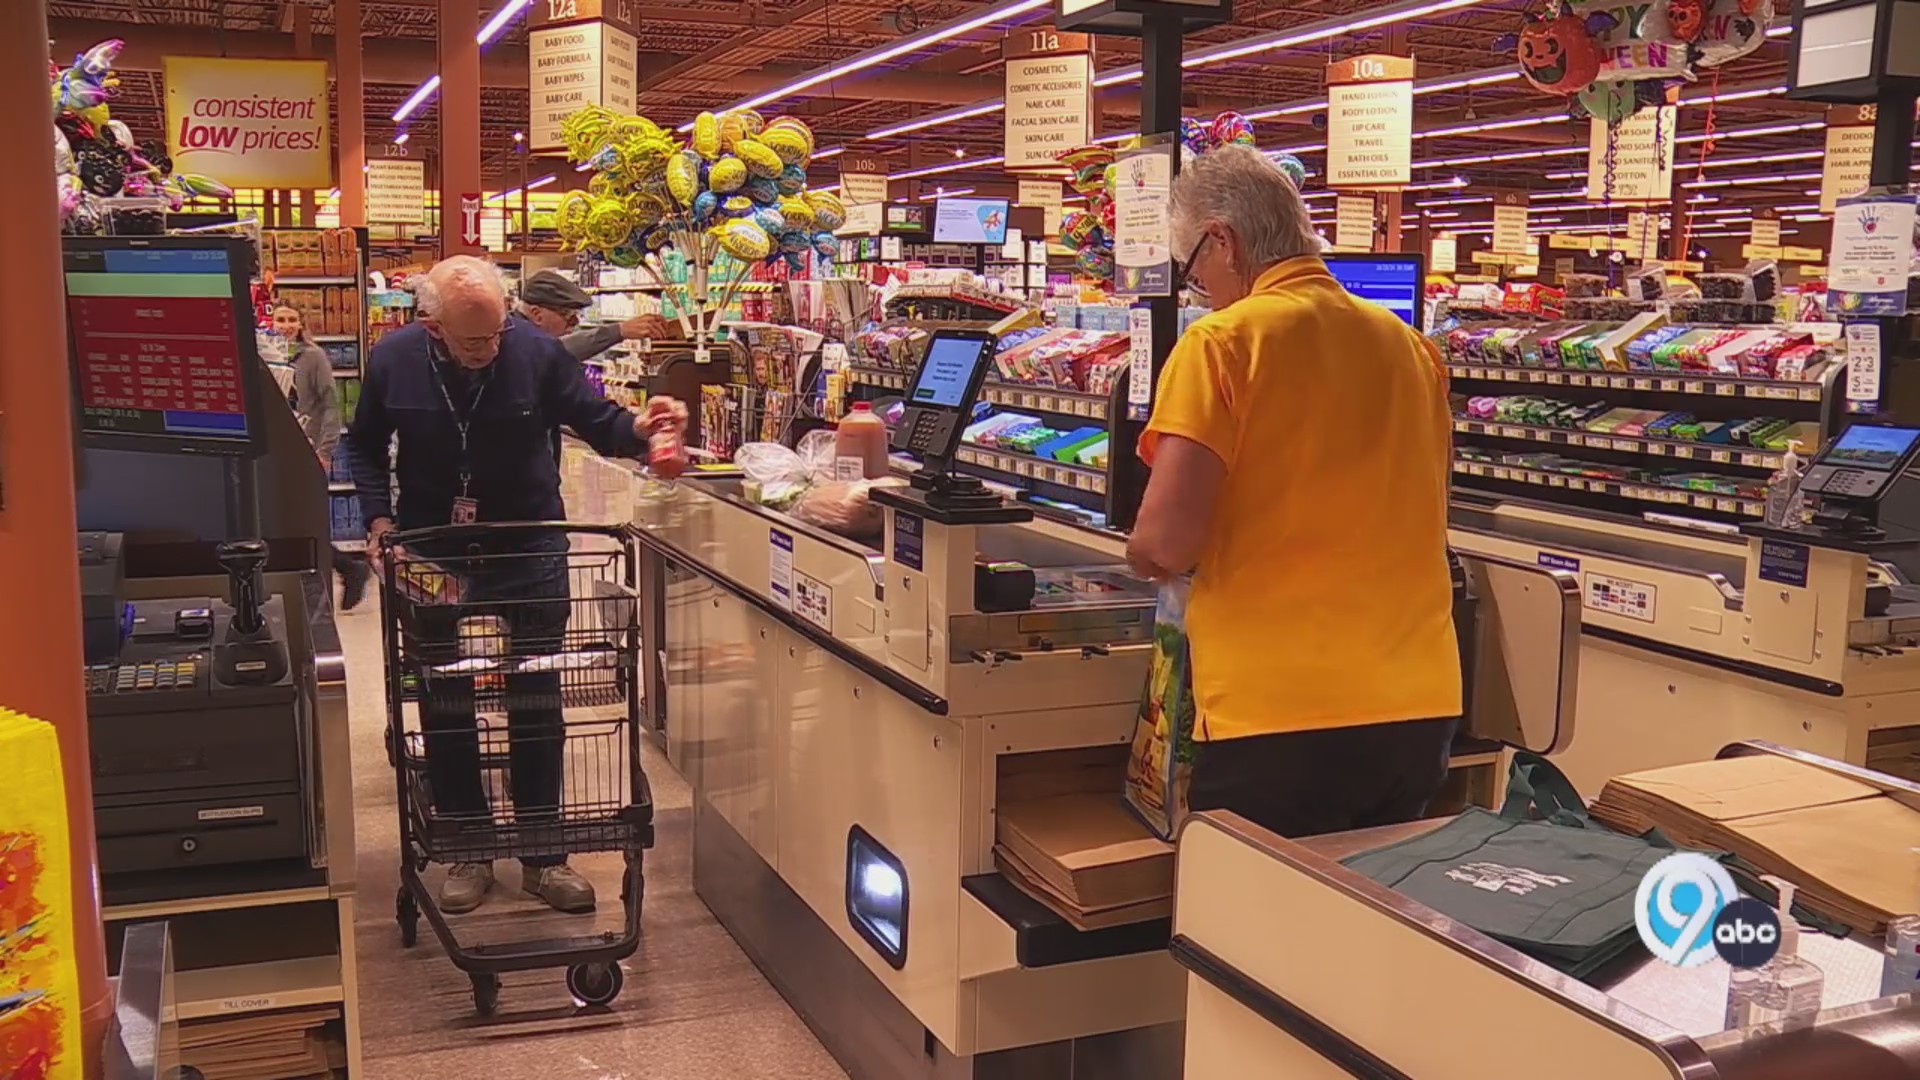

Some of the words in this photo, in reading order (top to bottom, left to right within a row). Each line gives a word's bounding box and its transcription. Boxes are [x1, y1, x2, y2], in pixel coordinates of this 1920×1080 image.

[547, 0, 577, 20] 12a
[544, 37, 562, 48] BABY
[563, 34, 585, 45] FOOD
[1031, 31, 1059, 52] 11a
[538, 57, 555, 68] BABY
[556, 53, 592, 65] FORMULA
[1023, 64, 1068, 76] COSMETICS
[1352, 59, 1384, 79] 10a
[544, 75, 562, 86] BABY
[563, 72, 585, 83] WIPES
[1010, 83, 1041, 94] COSMETIC
[1042, 80, 1082, 91] ACCESSORIES
[545, 94, 564, 105] BABY
[564, 92, 583, 102] CARE
[1341, 92, 1365, 102] HAND
[193, 94, 317, 120] consistent
[1025, 100, 1044, 109] NAIL
[1045, 98, 1066, 108] CARE
[1341, 107, 1365, 117] BODY
[1366, 106, 1398, 116] LOTION
[1011, 117, 1038, 127] FACIAL
[1039, 116, 1058, 126] SKIN
[1058, 114, 1080, 125] CARE
[1352, 123, 1364, 132] LIP
[1365, 122, 1386, 132] CARE
[1630, 128, 1653, 136] SOAP
[179, 116, 240, 148] low
[241, 125, 322, 155] prices!
[1025, 134, 1043, 143] SKIN
[1044, 132, 1065, 142] CARE
[1354, 138, 1384, 147] TRAVEL
[383, 145, 408, 157] 12b
[1025, 150, 1042, 160] SUN
[1043, 149, 1060, 159] CAR
[1829, 147, 1851, 155] HAIR
[1348, 155, 1370, 163] BATH
[1370, 153, 1389, 162] OILS
[856, 159, 876, 171] 10b
[1831, 160, 1851, 168] HAIR
[1337, 169, 1378, 179] ESSENTIAL
[1380, 168, 1398, 178] OILS
[1615, 172, 1647, 180] OTTON
[1840, 173, 1860, 181] HAIR
[223, 1001, 239, 1009] TILL
[240, 999, 270, 1008] COVER
